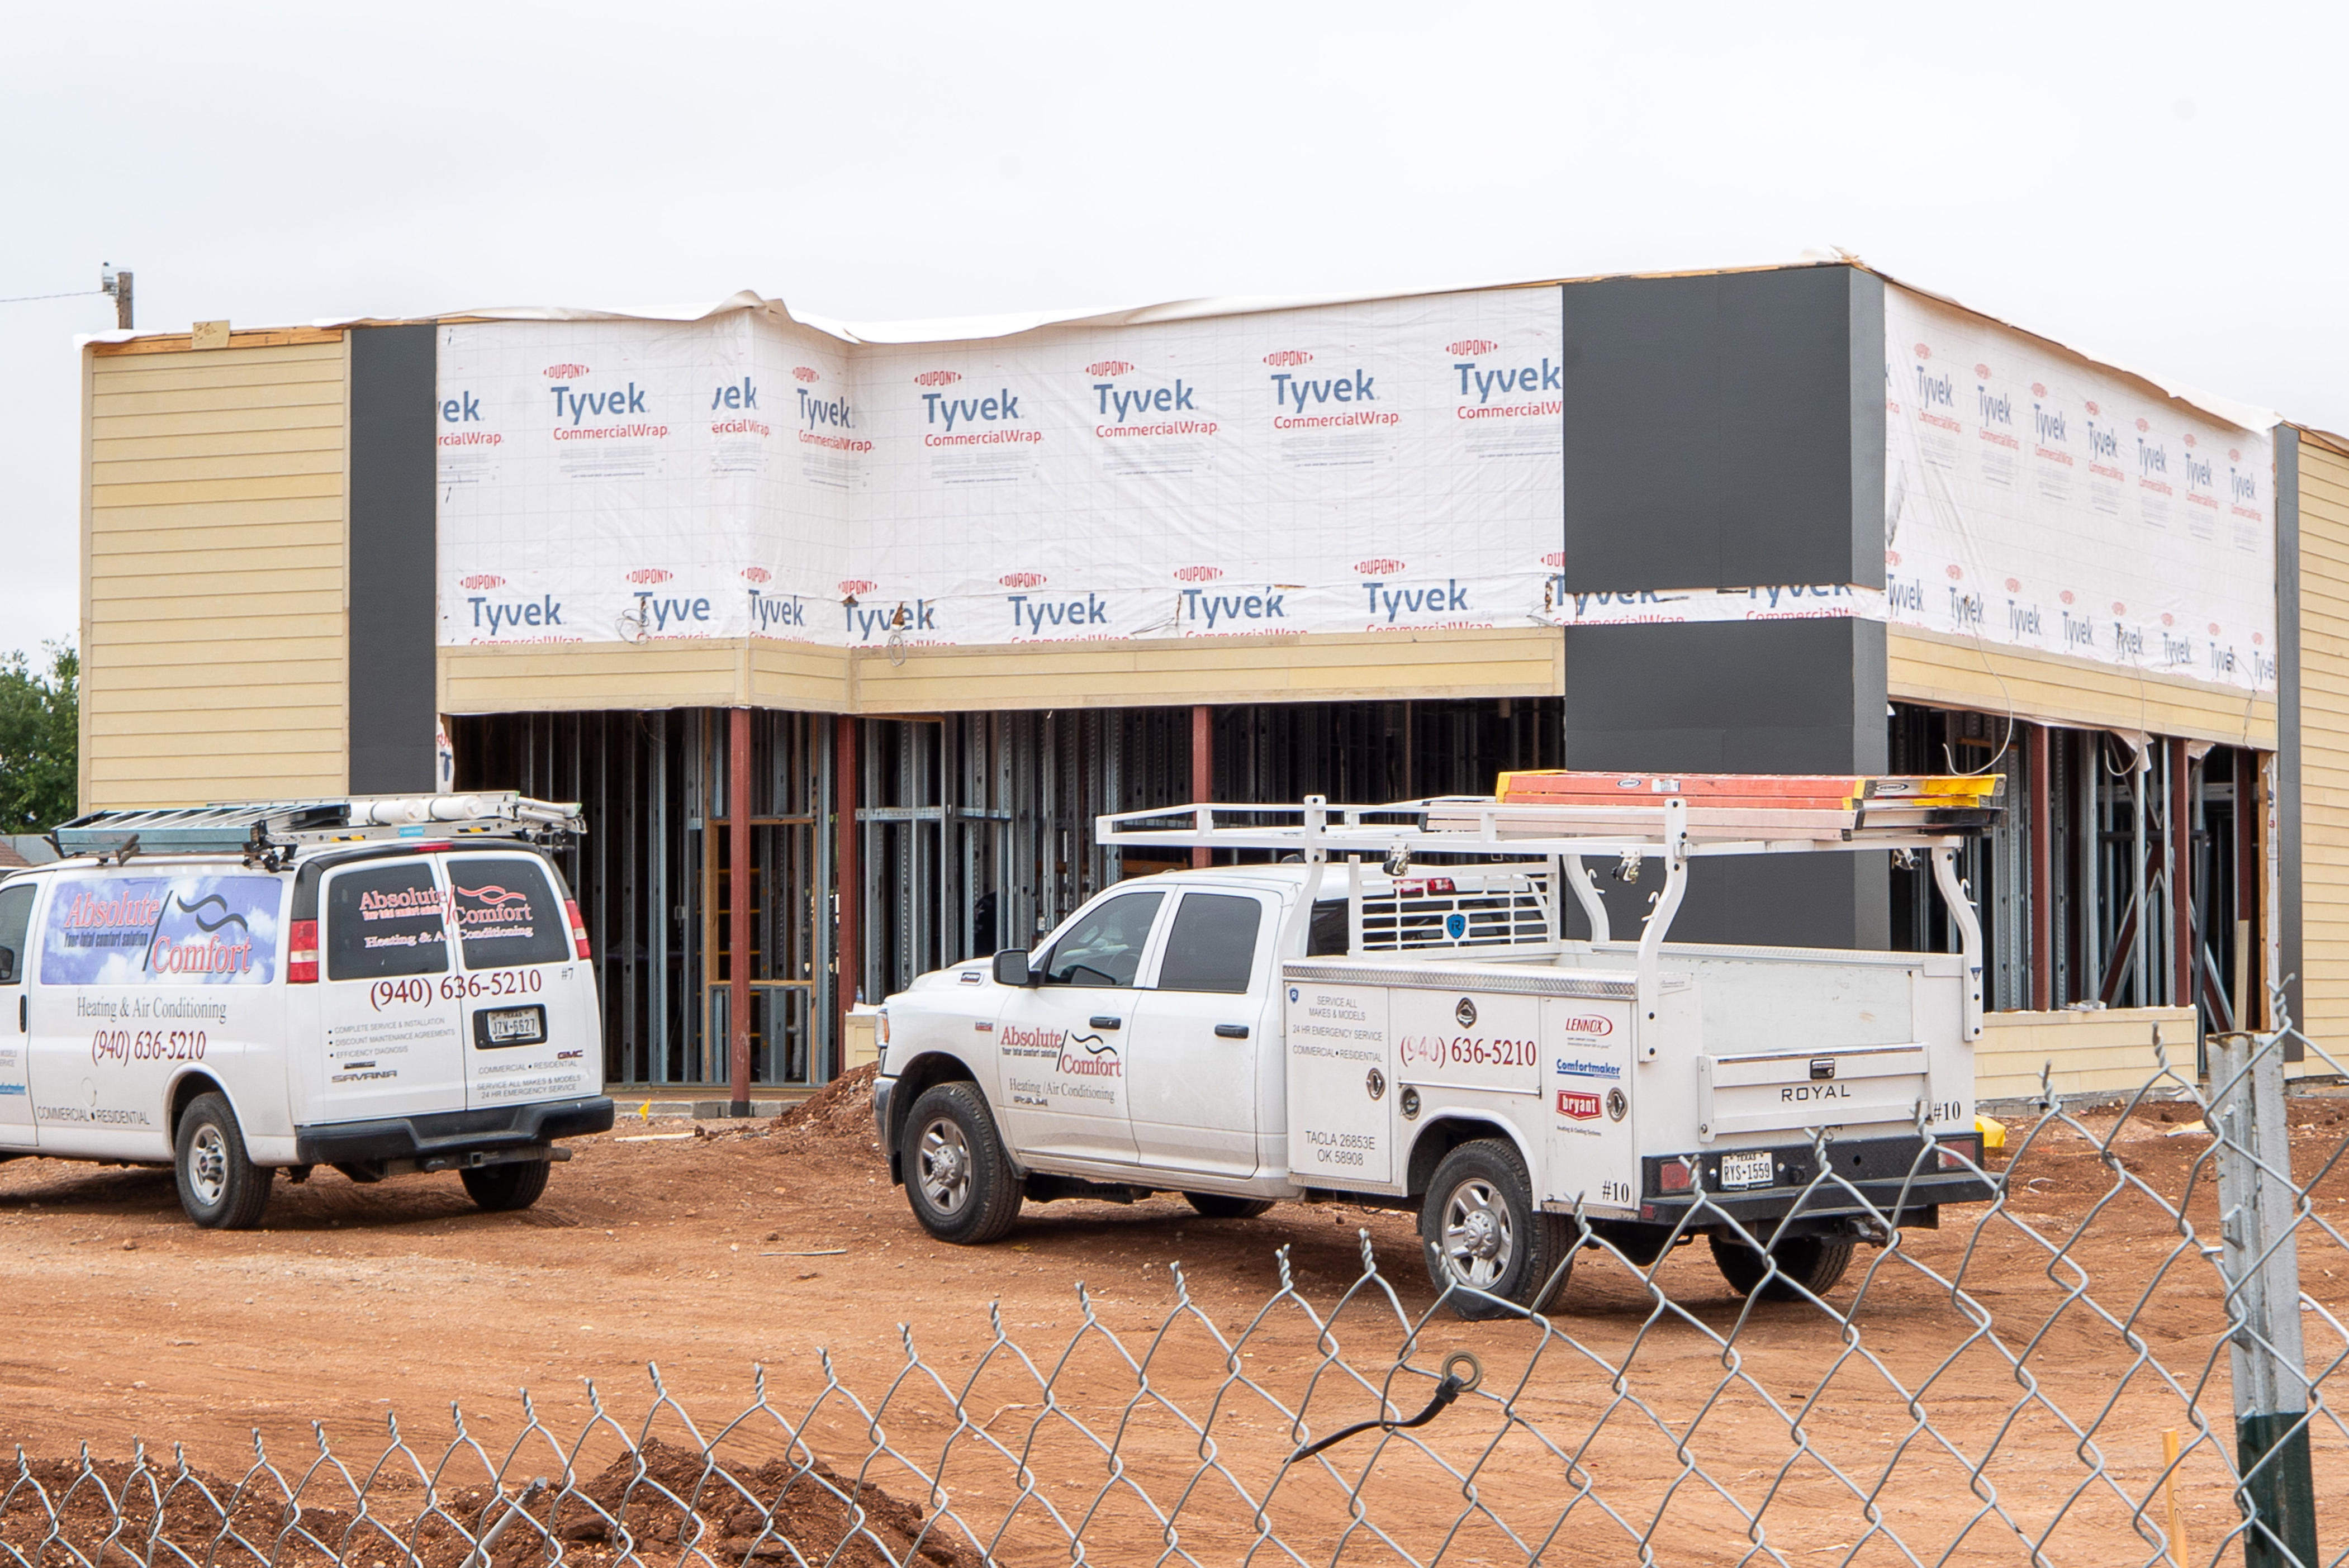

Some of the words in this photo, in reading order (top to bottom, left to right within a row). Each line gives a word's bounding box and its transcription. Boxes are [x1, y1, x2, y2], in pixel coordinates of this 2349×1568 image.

[1269, 350, 1308, 367] DUPONT
[1451, 339, 1492, 357] DUPONT
[549, 364, 584, 379] DUPONT
[920, 371, 956, 386] DUPONT
[1092, 361, 1129, 377] DUPONT
[1454, 358, 1562, 403] Tyvek
[1271, 369, 1375, 414] Tyvek
[1917, 365, 1954, 408] Tyvek
[438, 391, 480, 422] ek
[551, 382, 646, 425] Tyvek
[797, 388, 851, 430] Tyvek
[922, 388, 1018, 432] Tyvek
[1094, 379, 1194, 422] Tyvek
[1977, 384, 2012, 427] Tyvek
[1096, 421, 1217, 438] CommercialWrap
[1274, 411, 1398, 429] CommercialWrap
[2034, 403, 2067, 444] Tyvek
[553, 424, 668, 440] CommercialWrap
[799, 429, 872, 453] CommercialWrap
[925, 430, 1042, 446] CommercialWrap
[2087, 421, 2118, 460] Tyvek
[2137, 438, 2167, 476] Tyvek
[2185, 453, 2213, 490] Tyvek
[2231, 467, 2256, 503] Tyvek
[632, 569, 668, 583] DUPONT
[1180, 566, 1218, 581] DUPONT
[1360, 559, 1400, 574] DUPONT
[466, 574, 501, 590] DUPONT
[1004, 573, 1041, 588] DUPONT
[1363, 579, 1468, 623] Tyvek
[1887, 574, 1925, 616] Tyvek
[468, 594, 562, 636] Tyvek
[634, 591, 711, 631] Tyve
[748, 589, 804, 630] Tyvek
[1008, 593, 1107, 635] Tyvek
[1183, 586, 1285, 629] Tyvek
[1949, 587, 1985, 629] Tyvek
[843, 599, 935, 640] Tyvek
[2008, 600, 2042, 640] Tyvek
[2062, 611, 2095, 650] Tyvek
[2163, 632, 2192, 665] Tyvek
[64, 890, 160, 928] Absolute
[359, 887, 447, 910] Absolute
[452, 903, 533, 925] Comfort
[364, 934, 417, 948] Heating
[419, 932, 432, 943] &
[458, 926, 534, 940] Conditioning
[152, 934, 252, 973] Comfort
[561, 967, 574, 981] #7
[371, 977, 433, 1013] (940)
[440, 969, 542, 1000] 636-5210
[1317, 995, 1345, 1008] SERVICE
[1346, 998, 1358, 1008] ALL
[77, 997, 117, 1023] Heating
[120, 997, 129, 1018] &
[132, 997, 150, 1018] Air
[153, 997, 226, 1024] Conditioning
[1308, 1008, 1331, 1018] MAKES
[1338, 1010, 1366, 1021] MODELS
[335, 1024, 369, 1034] COMPLETE
[370, 1021, 397, 1031] SERVICE
[1000, 1025, 1062, 1049] Absolute
[1292, 1024, 1300, 1034] 24
[1301, 1025, 1311, 1034] HR
[1312, 1026, 1353, 1039] EMERGENCY
[1354, 1029, 1383, 1042] SERVICE
[1565, 1018, 1604, 1033] LENNOX
[92, 1030, 130, 1067] (940)
[134, 1030, 206, 1060] 636-5210
[557, 1049, 584, 1059] GMC
[1292, 1044, 1336, 1058] COMMERCIAL
[1339, 1049, 1383, 1062] RESIDENTIAL
[1401, 1035, 1446, 1069] (940)
[1451, 1037, 1536, 1067] 636-5210
[331, 1070, 398, 1083] SAVANA
[478, 1063, 526, 1075] COMMERCIAL
[533, 1060, 578, 1070] RESIDENTIAL
[1062, 1053, 1122, 1078] Comfort
[1556, 1058, 1621, 1075] Comfortmaker
[477, 1081, 507, 1090] SERVICE
[509, 1079, 520, 1087] ALL
[523, 1077, 547, 1086] MAKES
[554, 1074, 582, 1083] MODELS
[481, 1091, 490, 1099] 24
[491, 1090, 502, 1098] HR
[503, 1086, 547, 1096] EMERGENCY
[548, 1084, 577, 1093] SERVICE
[1009, 1077, 1042, 1097] Heating
[1061, 1082, 1115, 1104] Conditioning
[1782, 1084, 1851, 1103] ROYAL
[1014, 1095, 1048, 1106] RAM
[1563, 1095, 1597, 1114] bryant
[1933, 1101, 1961, 1122] #10
[37, 1106, 90, 1122] COMMERCIAL
[96, 1109, 150, 1125] RESIDENTIAL
[1306, 1130, 1337, 1146] TACLA
[1340, 1133, 1375, 1150] 26853E
[1317, 1148, 1332, 1163] OK
[1335, 1151, 1364, 1166] 58908
[1602, 1180, 1630, 1203] #10
